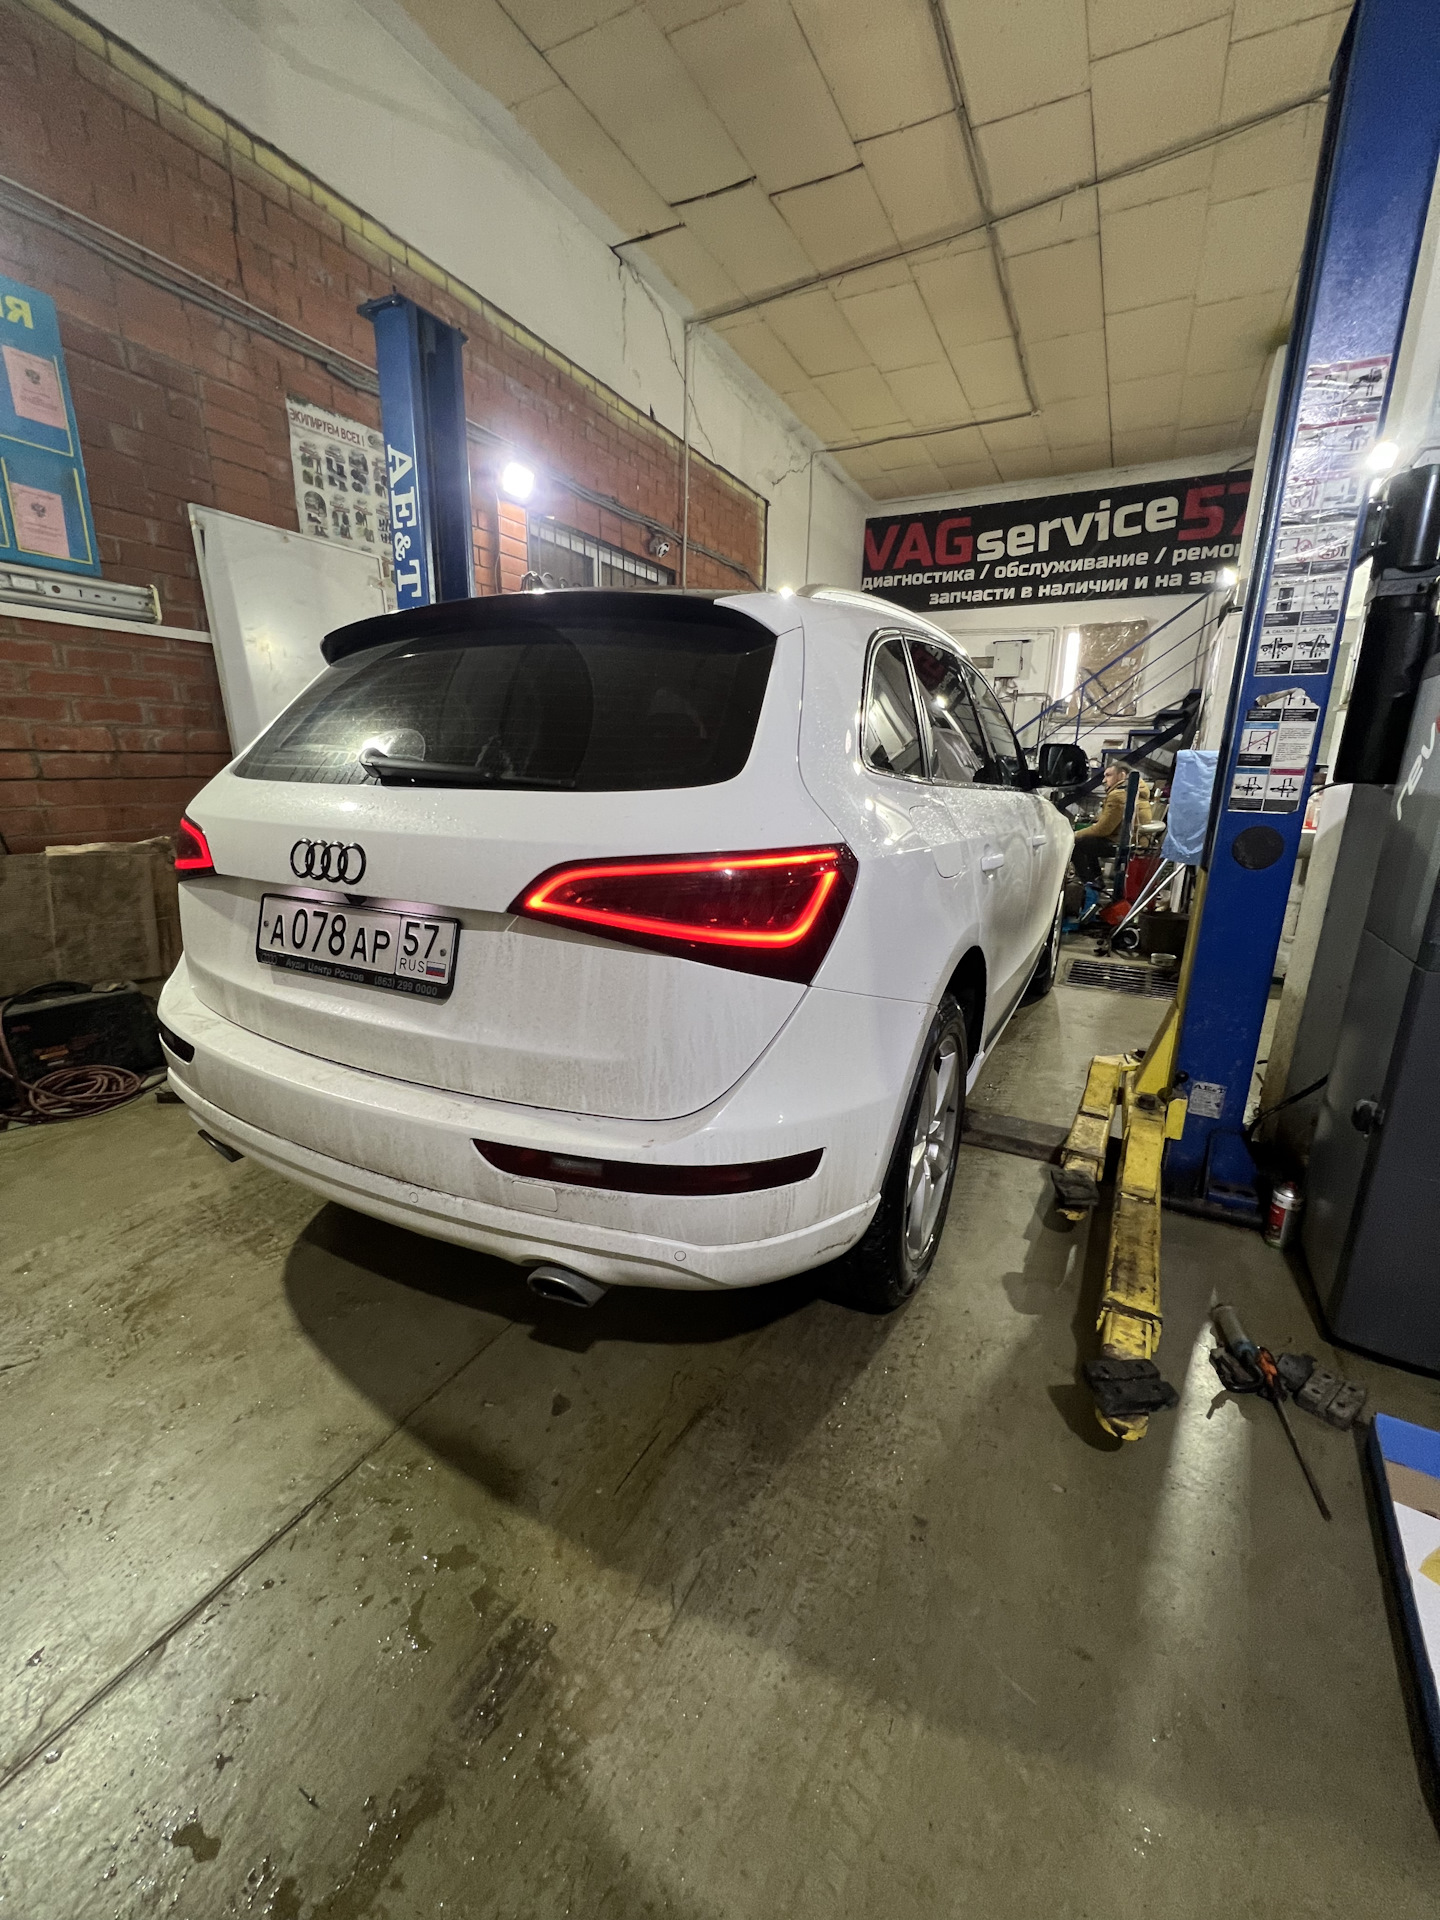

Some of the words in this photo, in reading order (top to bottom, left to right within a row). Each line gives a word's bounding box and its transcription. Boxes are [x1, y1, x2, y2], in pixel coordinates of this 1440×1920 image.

[387, 444, 422, 598] AE&T
[861, 568, 975, 591] диагностика
[994, 551, 1149, 579] обслуживание
[929, 587, 1016, 605] запчасти
[1020, 585, 1033, 599] в
[1037, 577, 1129, 598] наличии
[1134, 575, 1149, 590] и
[1154, 572, 1183, 588] на
[402, 921, 440, 958] 57
[285, 957, 306, 970] Ауди
[307, 961, 332, 977] Центр
[334, 967, 365, 982] Ростов
[374, 974, 397, 989] (863)
[396, 979, 414, 992] 299
[415, 984, 438, 997] 0000
[400, 957, 425, 973] RUS
